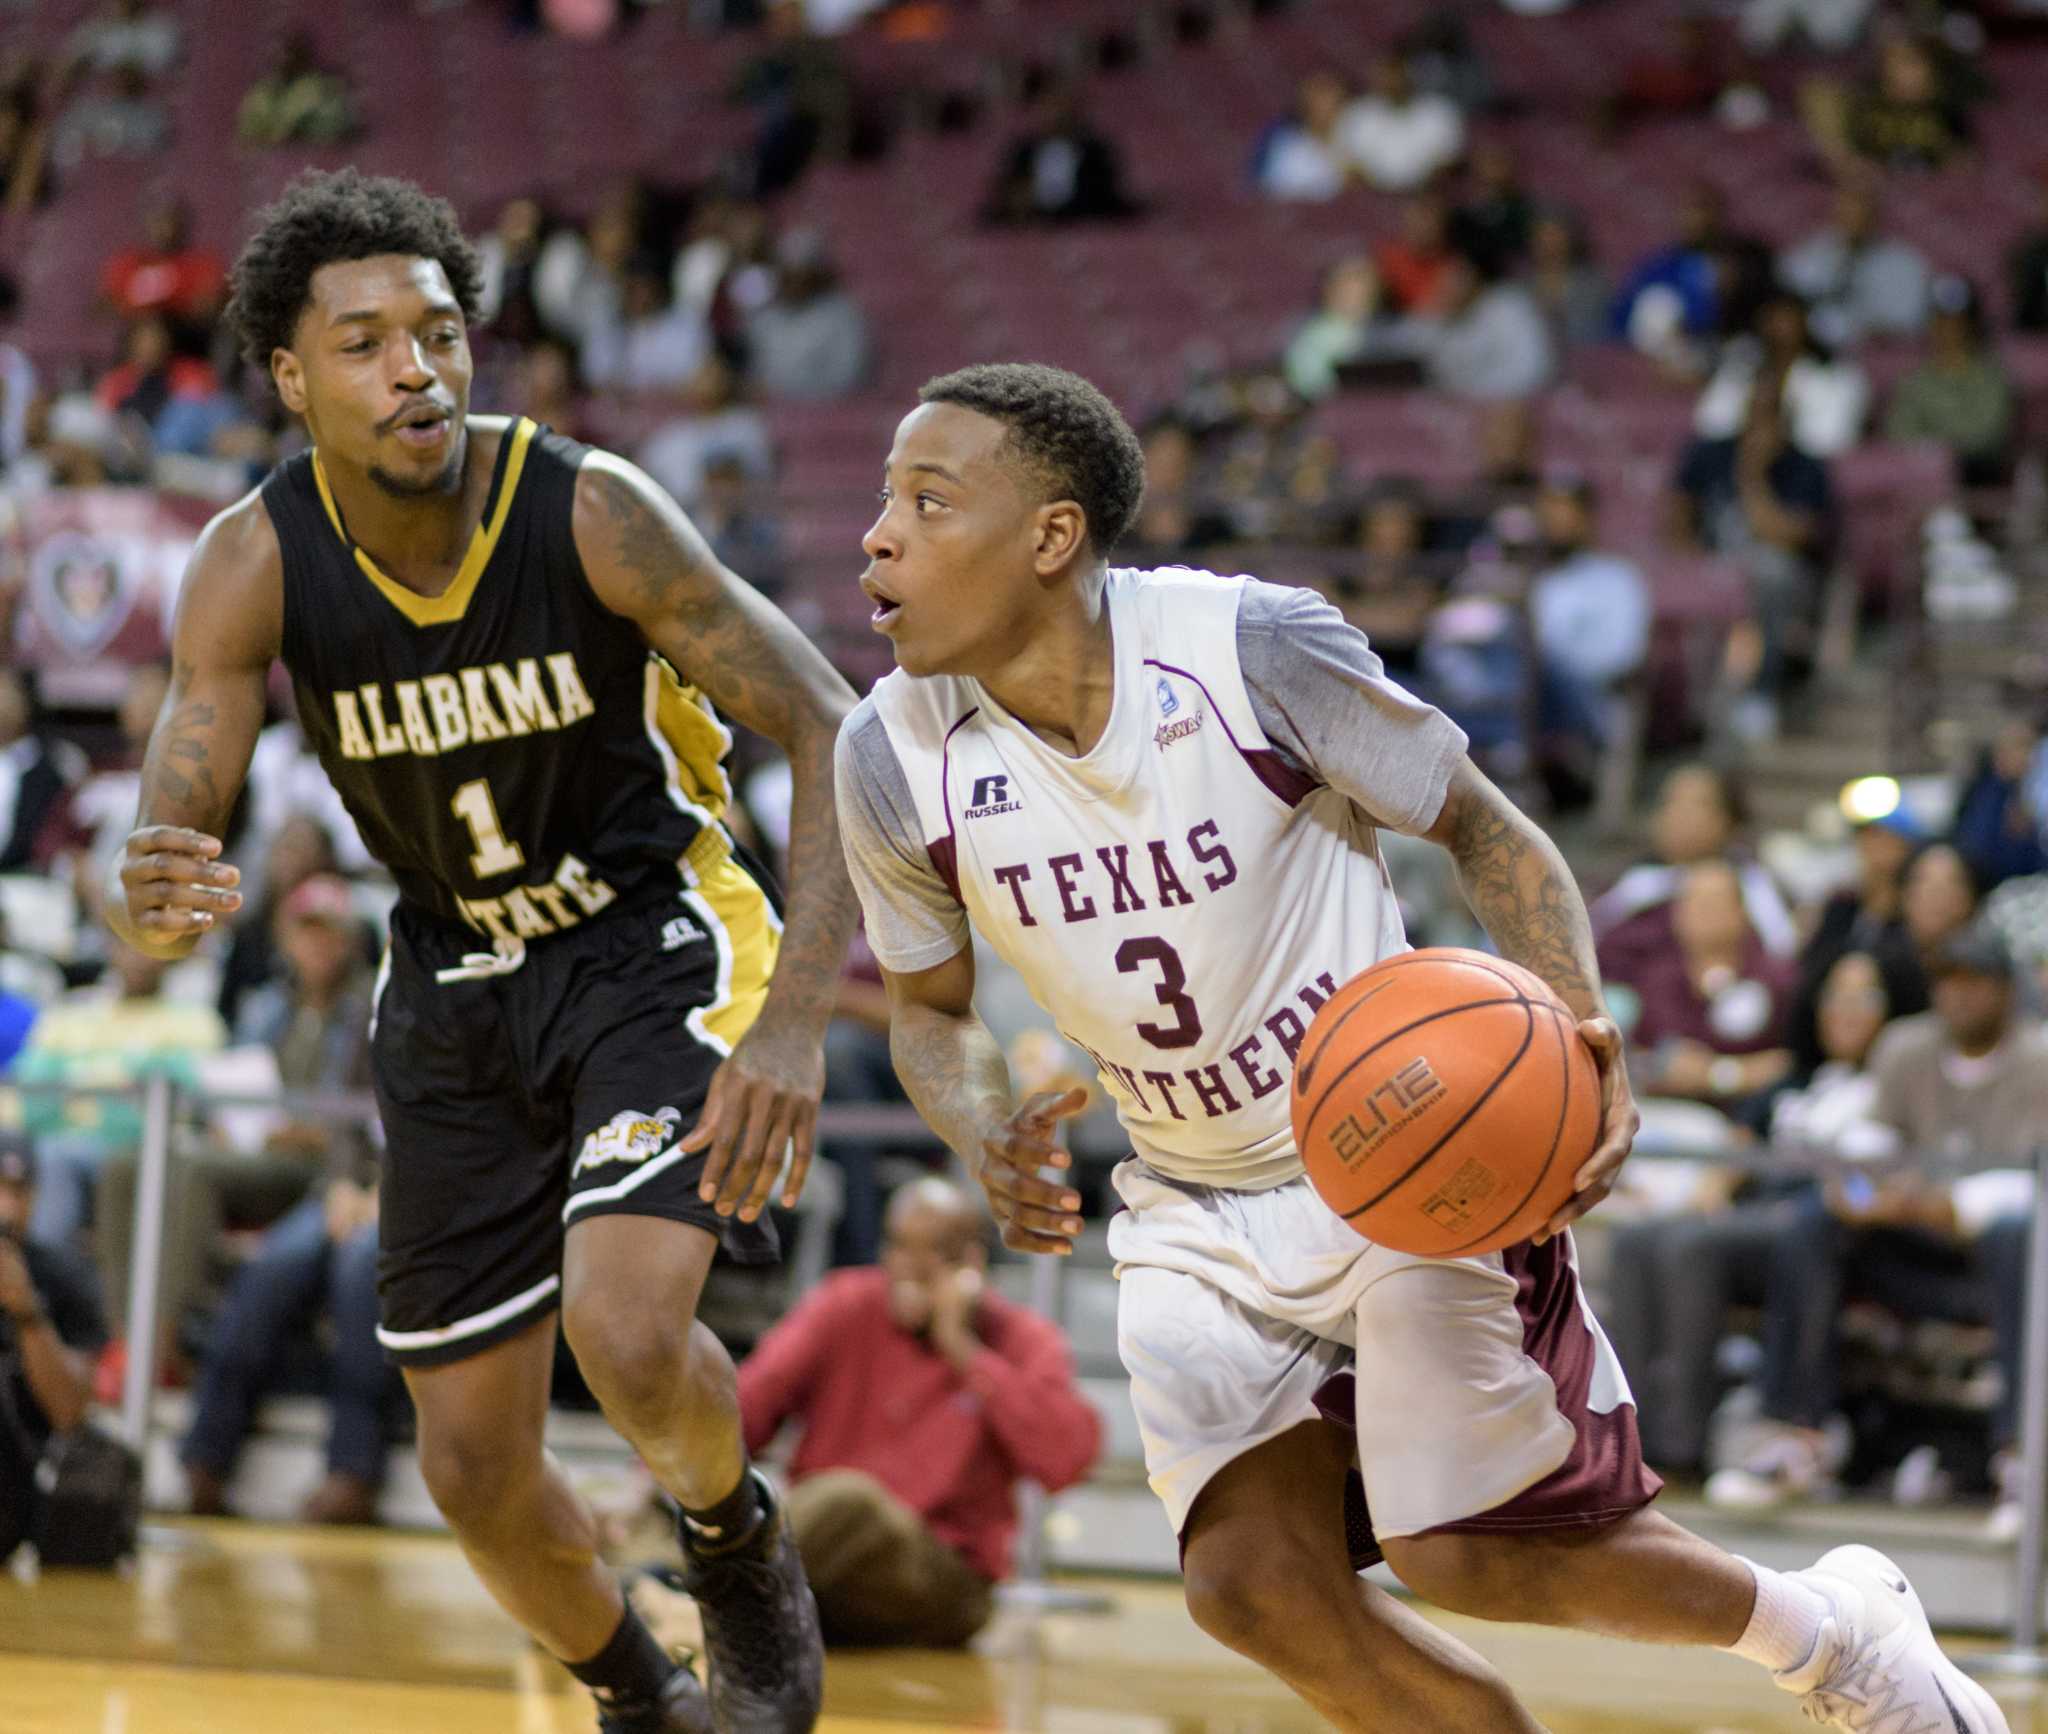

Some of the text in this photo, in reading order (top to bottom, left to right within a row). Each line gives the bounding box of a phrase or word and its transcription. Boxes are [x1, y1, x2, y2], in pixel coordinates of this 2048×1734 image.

[333, 651, 595, 759] ALABAMA
[451, 778, 526, 880] 1
[964, 801, 1023, 820] RUSSELL
[456, 853, 617, 941] TATE
[994, 818, 1238, 927] TEXAS
[1115, 935, 1204, 1050] 3
[1328, 1056, 1442, 1163] ELITE
